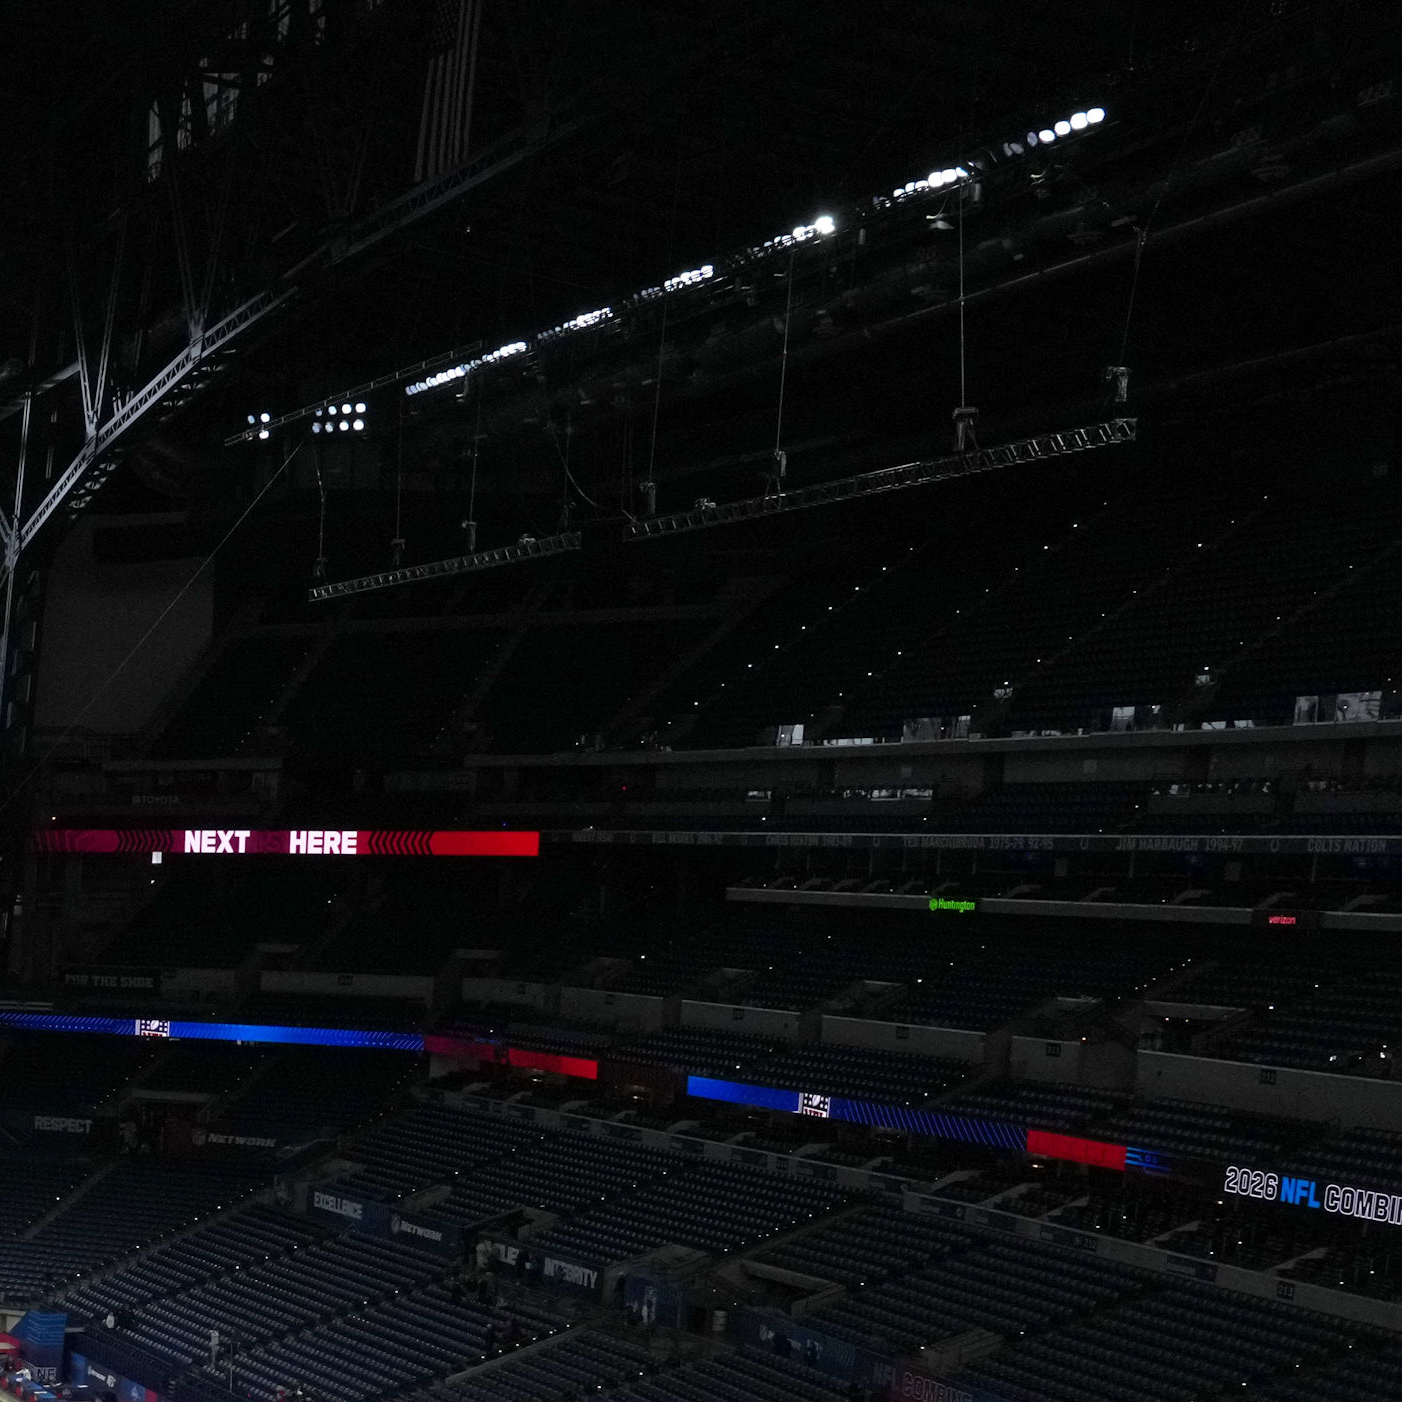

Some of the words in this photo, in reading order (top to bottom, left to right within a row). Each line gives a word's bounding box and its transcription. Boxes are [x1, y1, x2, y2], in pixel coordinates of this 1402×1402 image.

[183, 830, 251, 856] NEXT
[289, 830, 358, 856] HERE
[34, 1115, 92, 1134] RESPECT
[1224, 1166, 1279, 1201] 2026
[1279, 1176, 1321, 1209] NFL
[313, 1191, 363, 1221] EXCELLENCE
